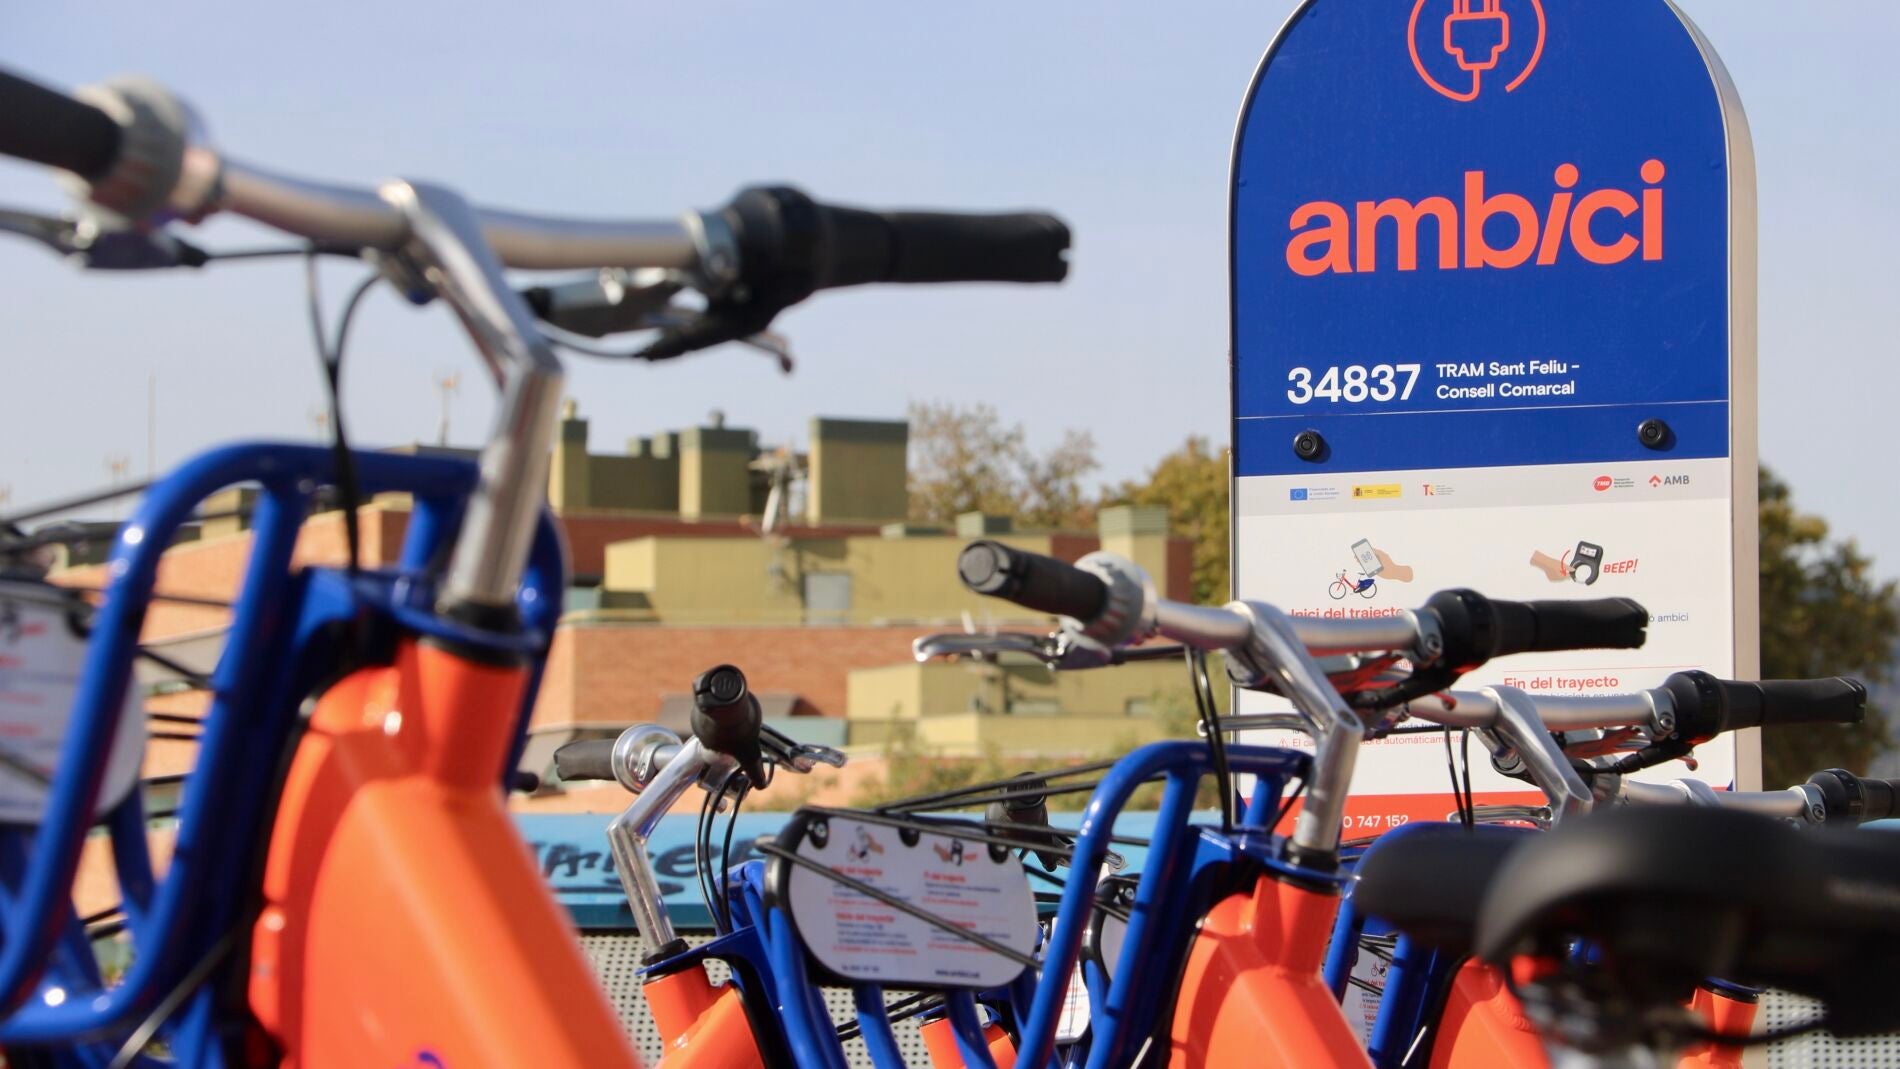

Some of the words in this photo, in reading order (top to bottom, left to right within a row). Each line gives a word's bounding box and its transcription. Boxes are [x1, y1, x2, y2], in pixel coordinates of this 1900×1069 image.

[1285, 159, 1666, 277] ambici
[1436, 363, 1484, 378] TRAM
[1489, 361, 1525, 377] Sant
[1529, 360, 1567, 375] Feliu
[1287, 363, 1421, 404] 34837
[1436, 383, 1495, 399] Consell
[1499, 381, 1575, 397] Comarcal
[1664, 475, 1690, 486] AMB
[1603, 559, 1639, 574] BEEP!
[1324, 608, 1346, 619] del
[1658, 612, 1689, 623] ambici
[1504, 677, 1526, 689] Fin
[1530, 676, 1552, 689] del
[1557, 676, 1619, 691] trayecto
[1357, 815, 1381, 828] 747
[1385, 814, 1409, 828] 152
